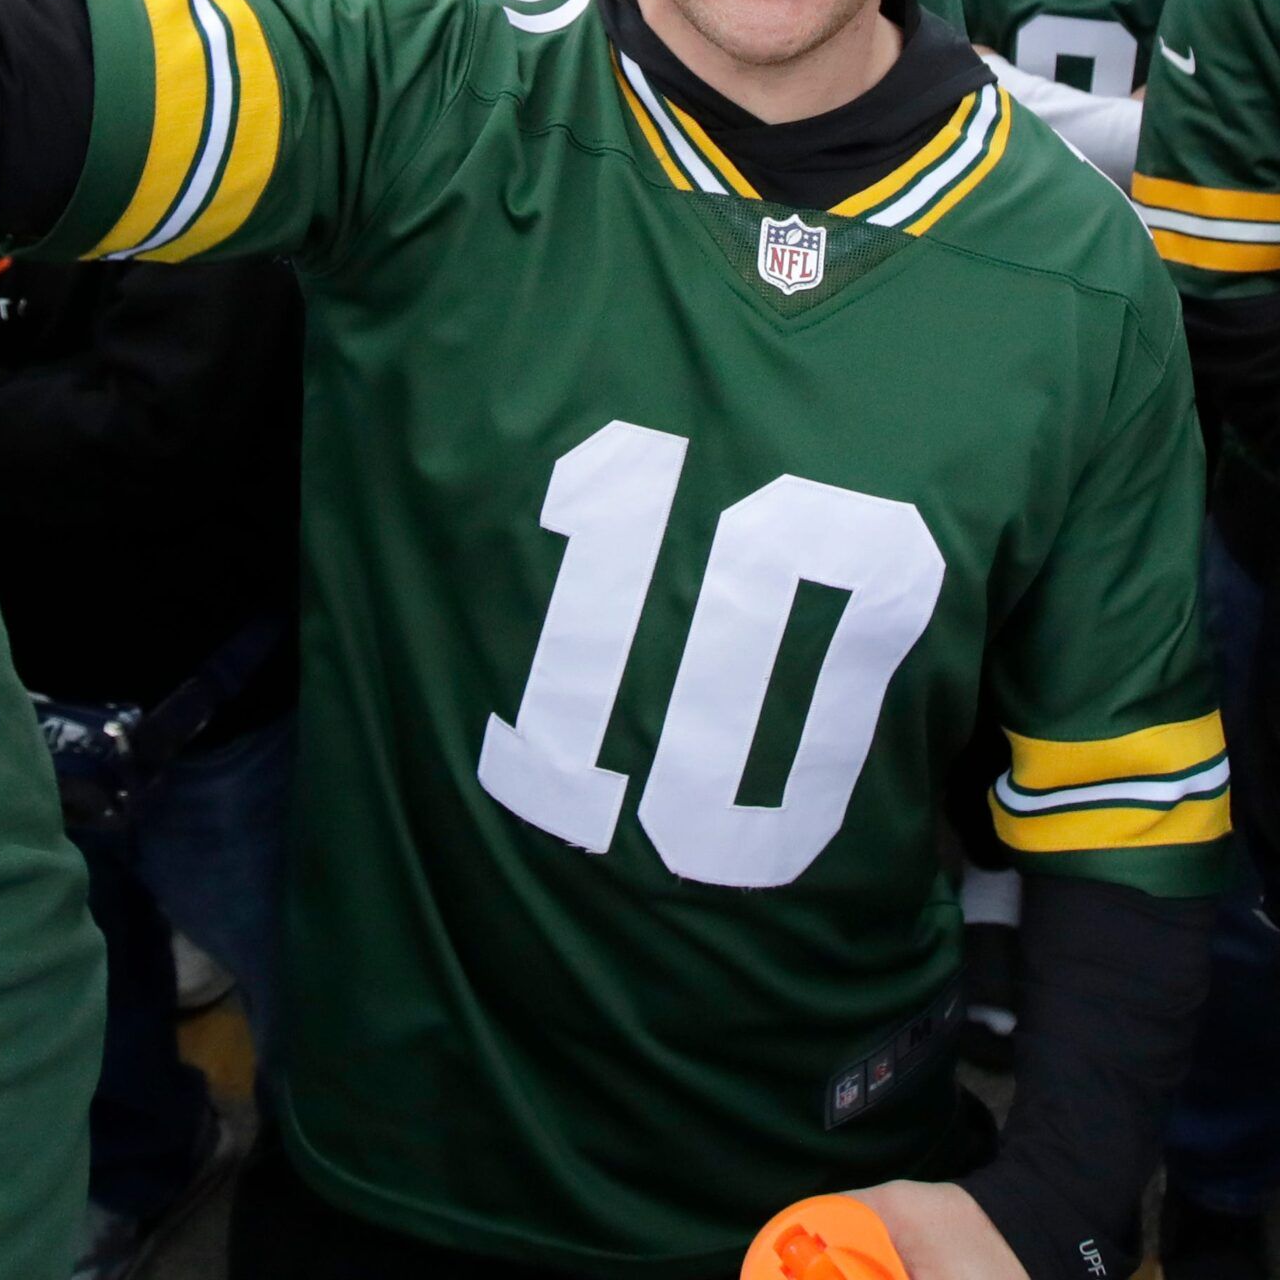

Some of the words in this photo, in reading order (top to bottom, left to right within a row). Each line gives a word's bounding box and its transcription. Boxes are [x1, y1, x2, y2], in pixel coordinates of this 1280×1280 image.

[769, 246, 813, 280] NFL
[476, 419, 947, 888] 10
[1079, 1238, 1107, 1278] UPF
